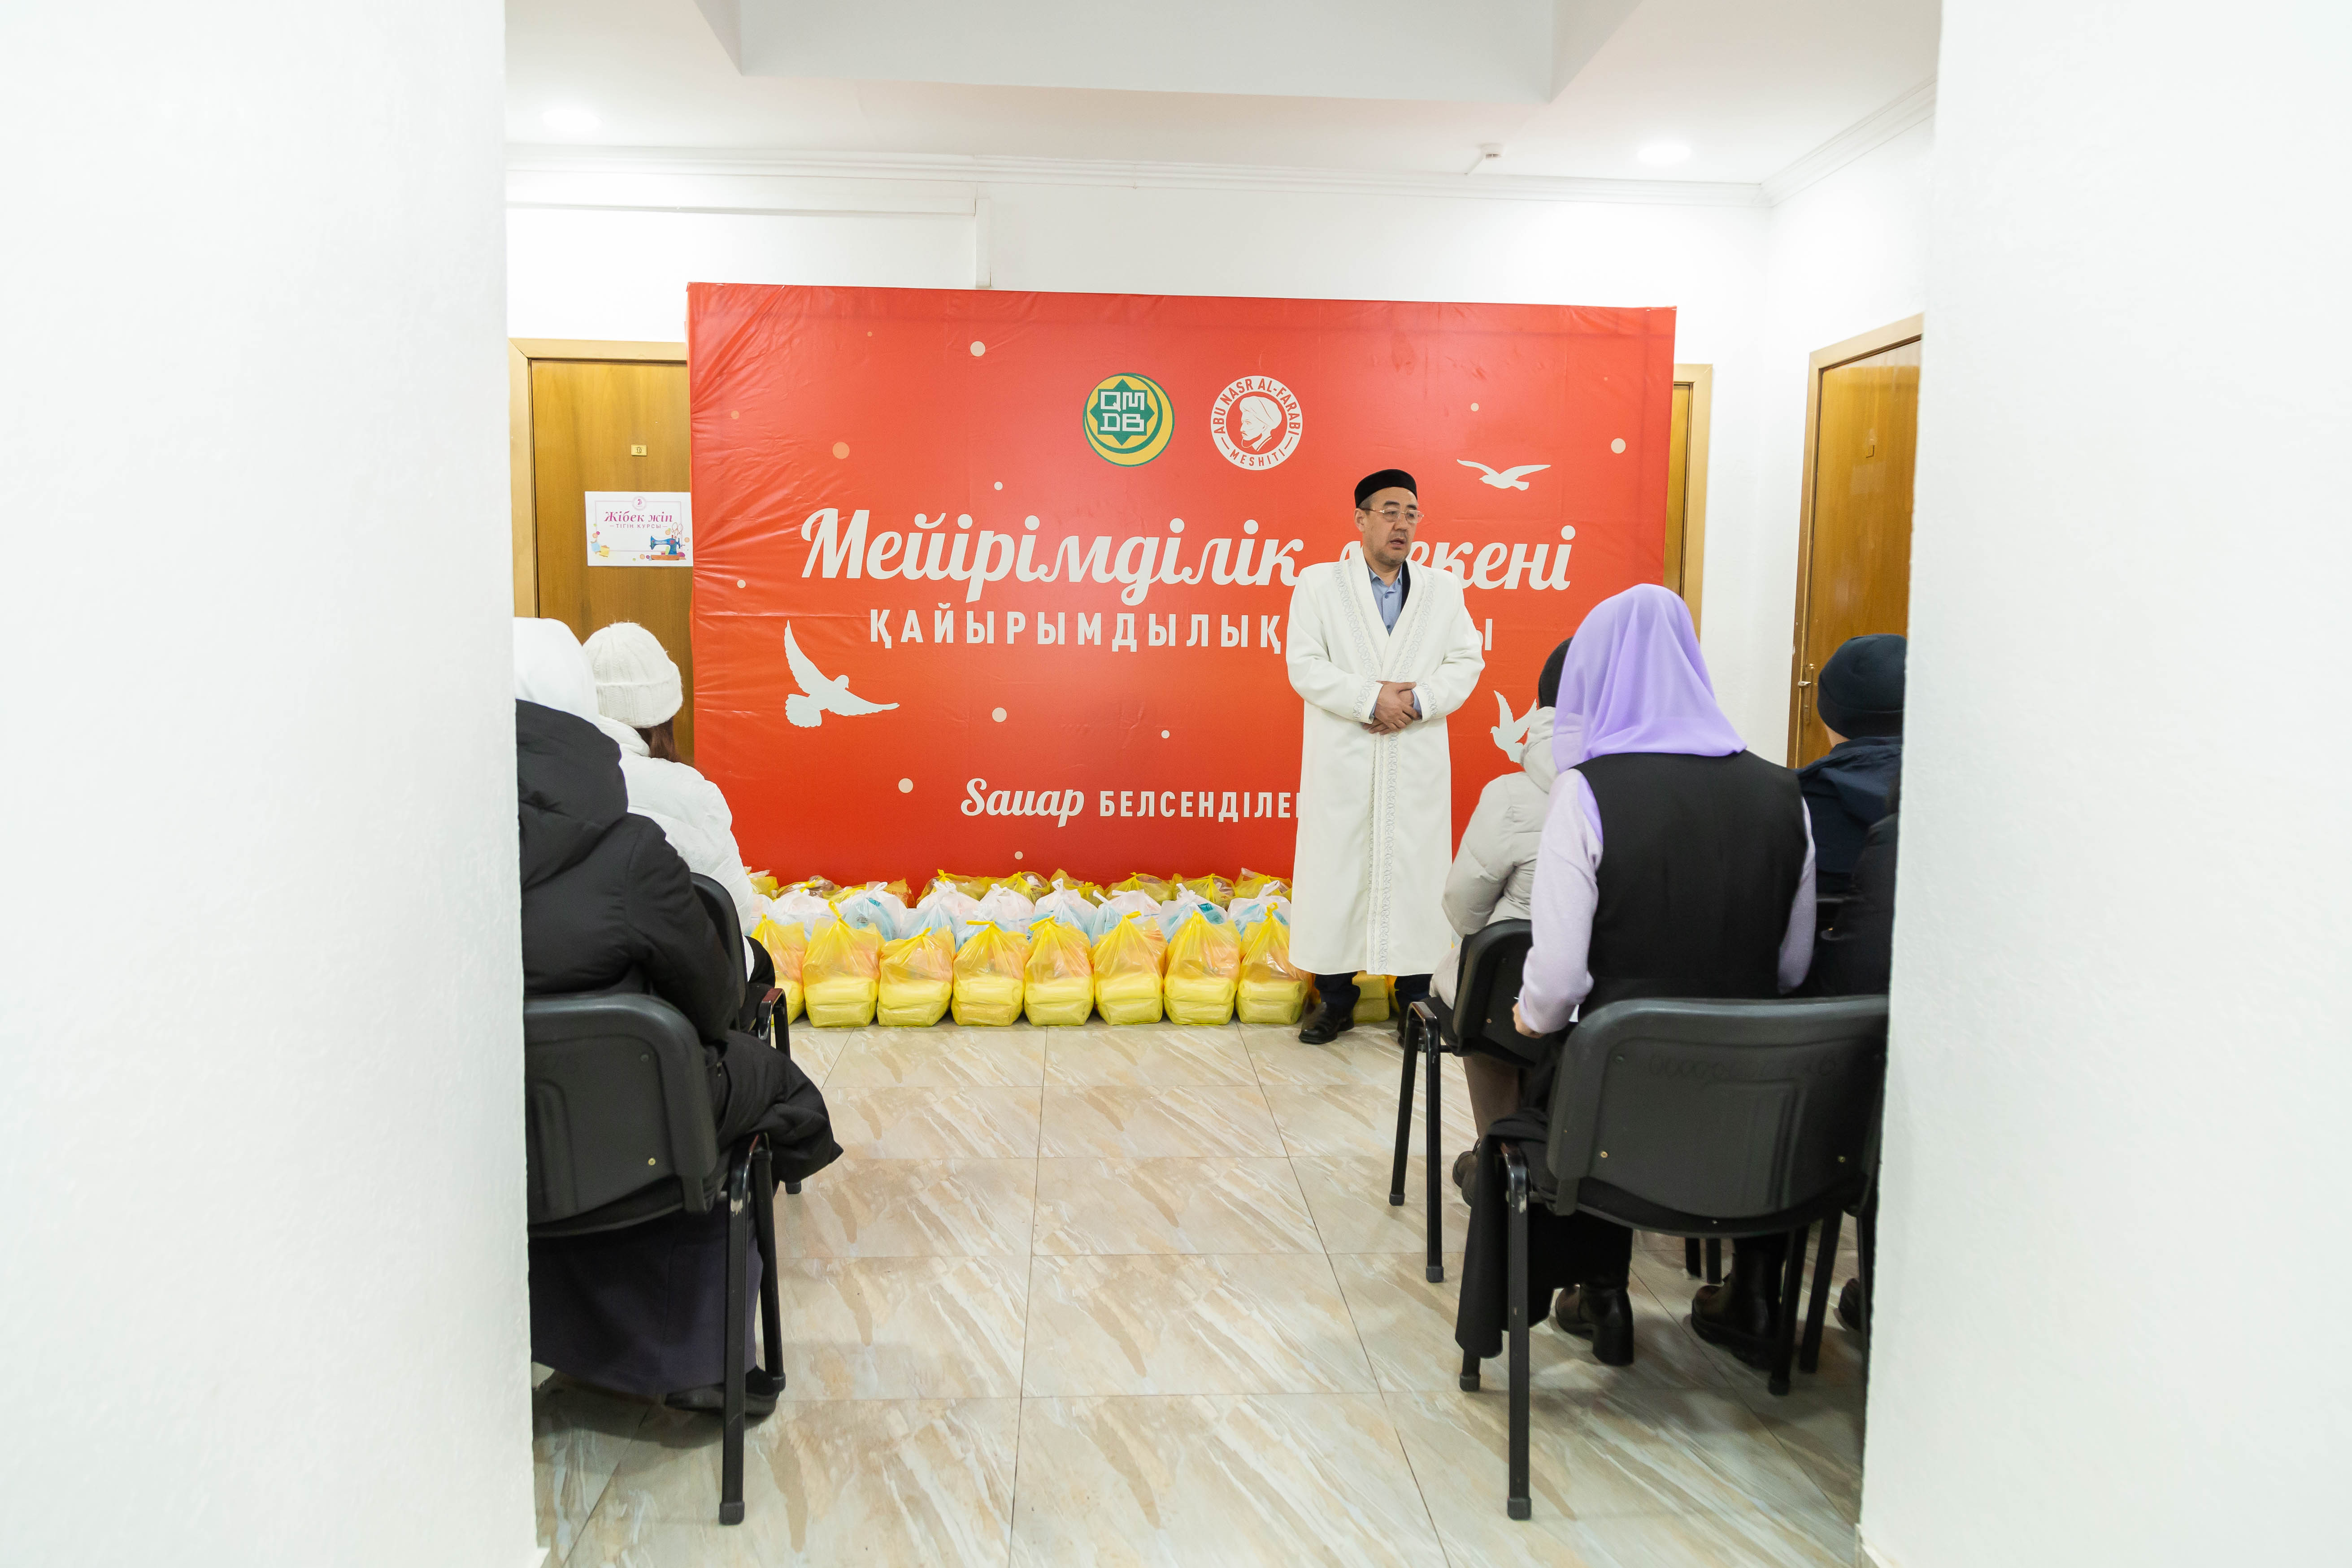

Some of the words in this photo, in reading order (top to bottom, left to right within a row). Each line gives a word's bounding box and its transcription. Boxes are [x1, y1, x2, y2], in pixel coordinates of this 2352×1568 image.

[1213, 407, 1226, 434] ABU
[1220, 378, 1253, 405] NASR
[1258, 378, 1300, 435] AL-FARABI
[1230, 449, 1285, 466] MESHITI
[604, 511, 644, 522] Жібек
[648, 512, 673, 522] жіп
[801, 508, 1304, 606] Мейірімділік
[870, 603, 1281, 654] ҚАЙЫРЫМДЫЛЫҚ
[1100, 791, 1300, 822] БЕЛСЕНДІЛЕ
